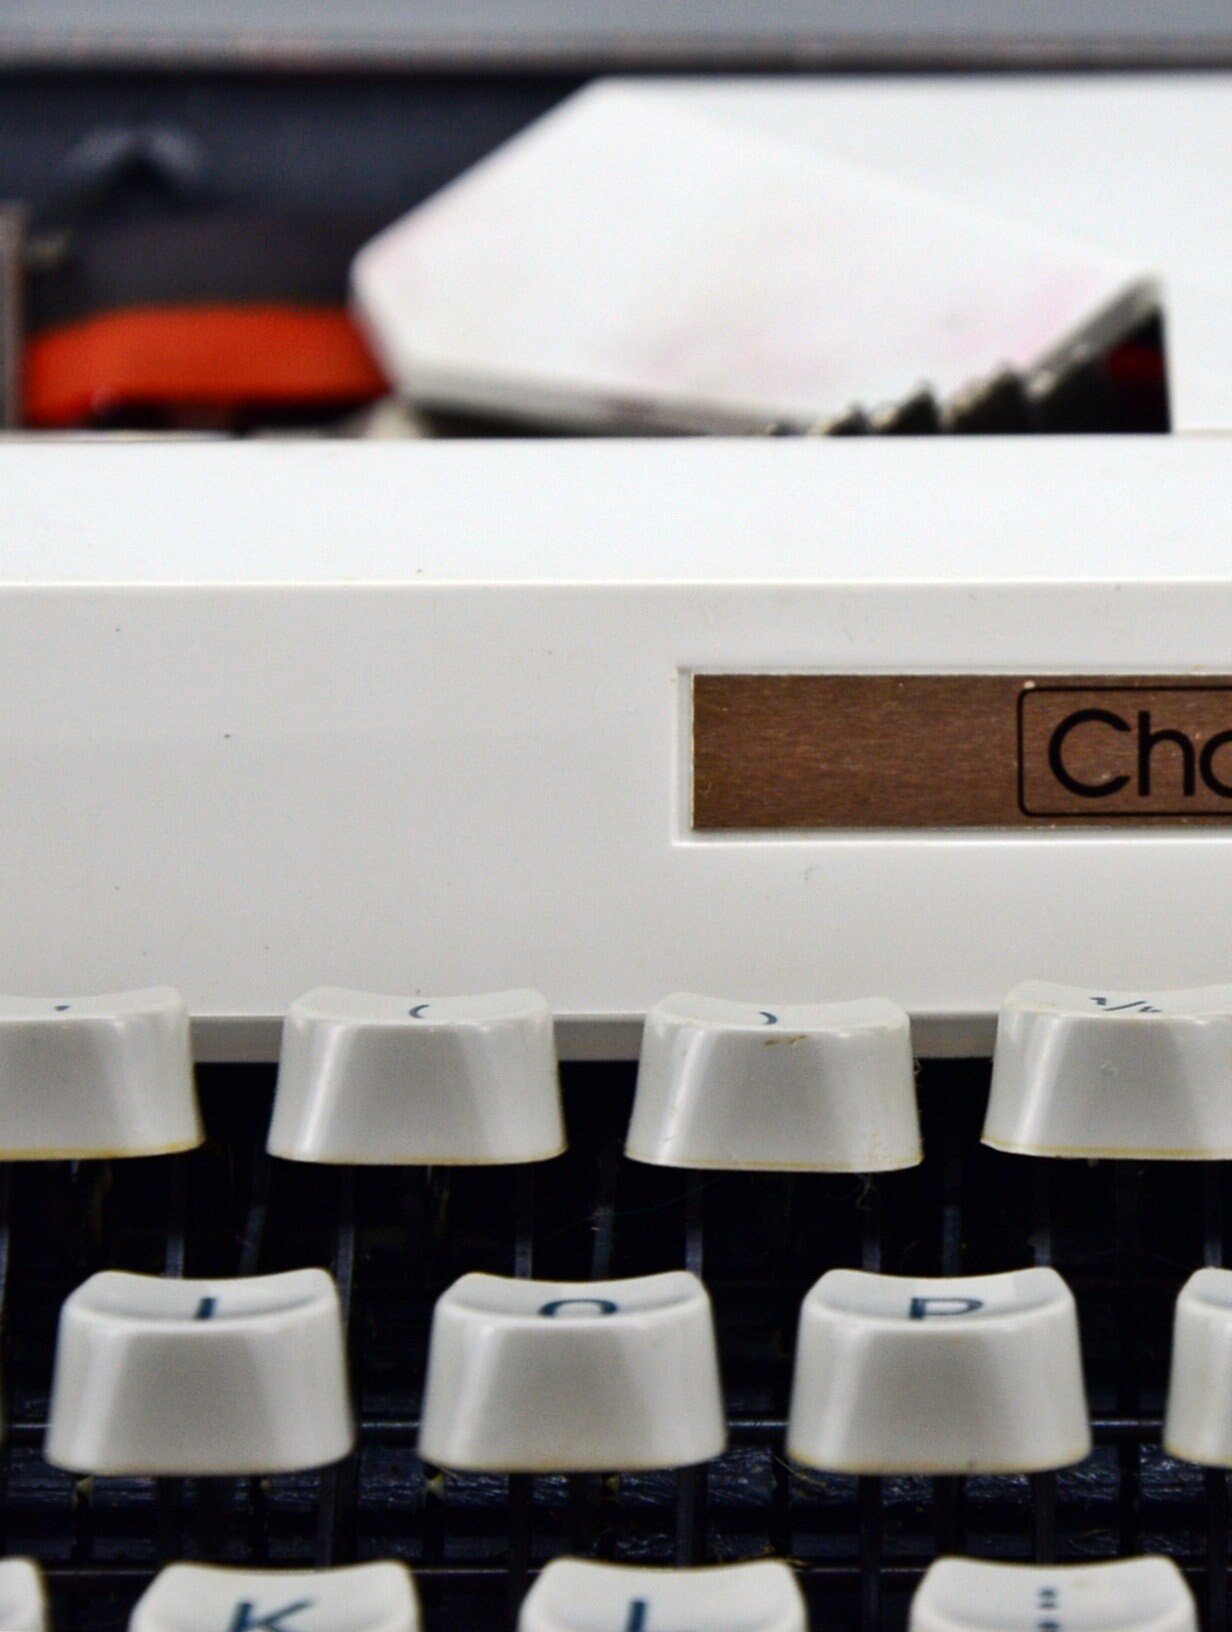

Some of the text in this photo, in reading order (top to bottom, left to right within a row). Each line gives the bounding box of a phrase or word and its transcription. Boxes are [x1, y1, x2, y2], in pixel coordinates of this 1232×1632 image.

[408, 1004, 430, 1020] (
[757, 1011, 778, 1026] )
[909, 1297, 983, 1320] P
